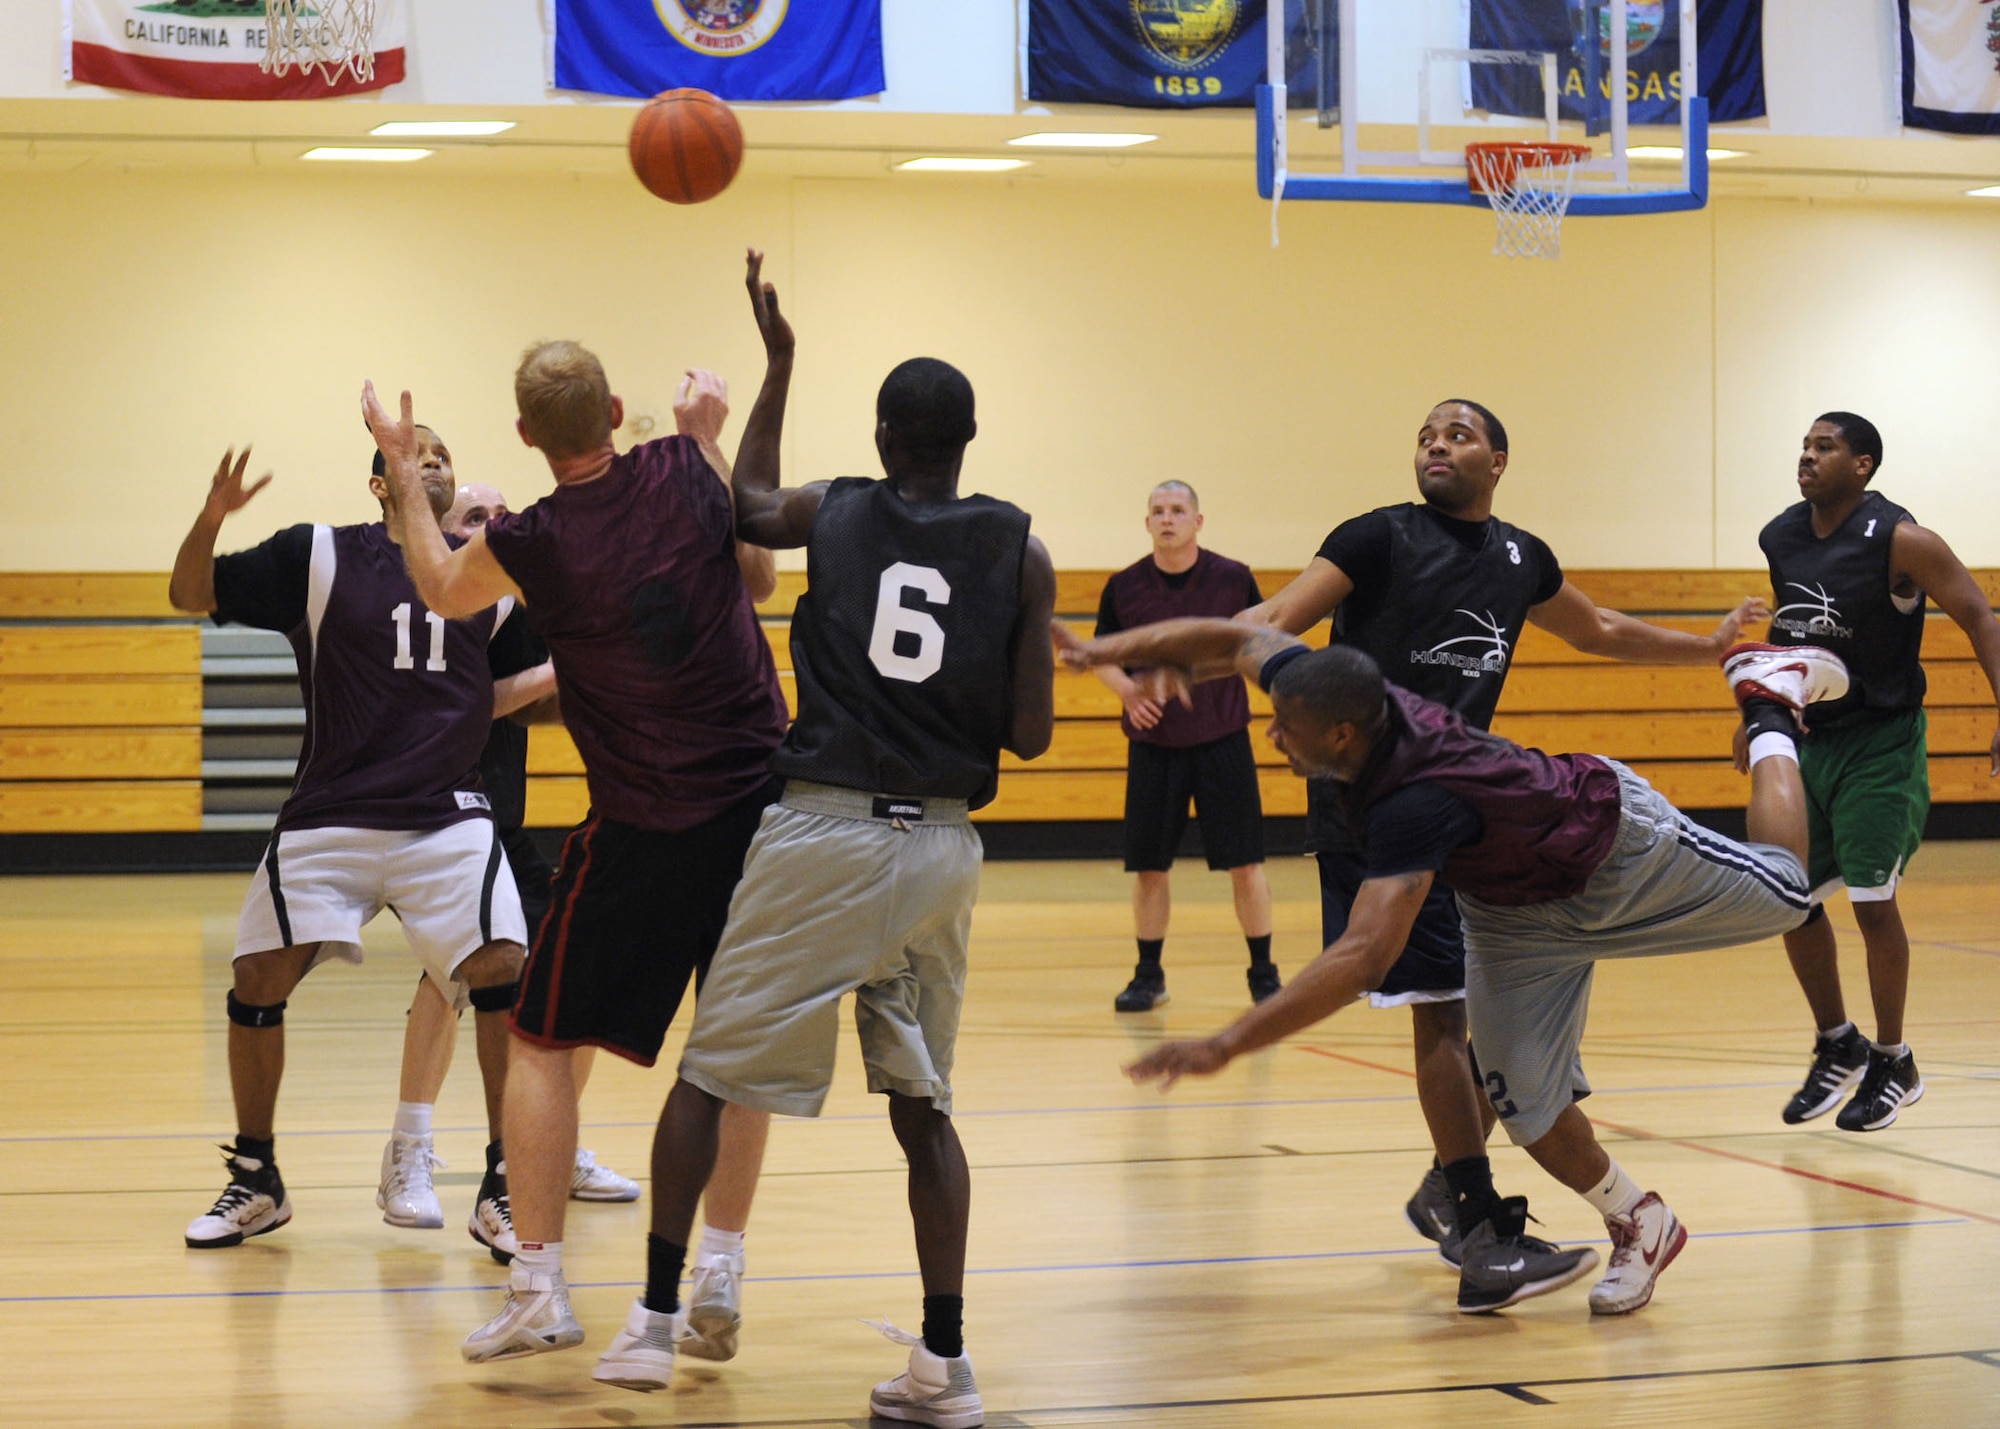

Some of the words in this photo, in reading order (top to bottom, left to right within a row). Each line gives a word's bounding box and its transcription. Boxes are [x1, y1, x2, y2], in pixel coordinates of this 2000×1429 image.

[124, 19, 230, 48] CALIFORNIA
[246, 27, 330, 49] REUBLIC
[1154, 75, 1222, 96] 1859
[1864, 519, 1877, 537] 1
[1506, 540, 1522, 565] 3
[391, 602, 446, 672] 11
[868, 561, 951, 683] 6
[1486, 1071, 1519, 1119] 2
